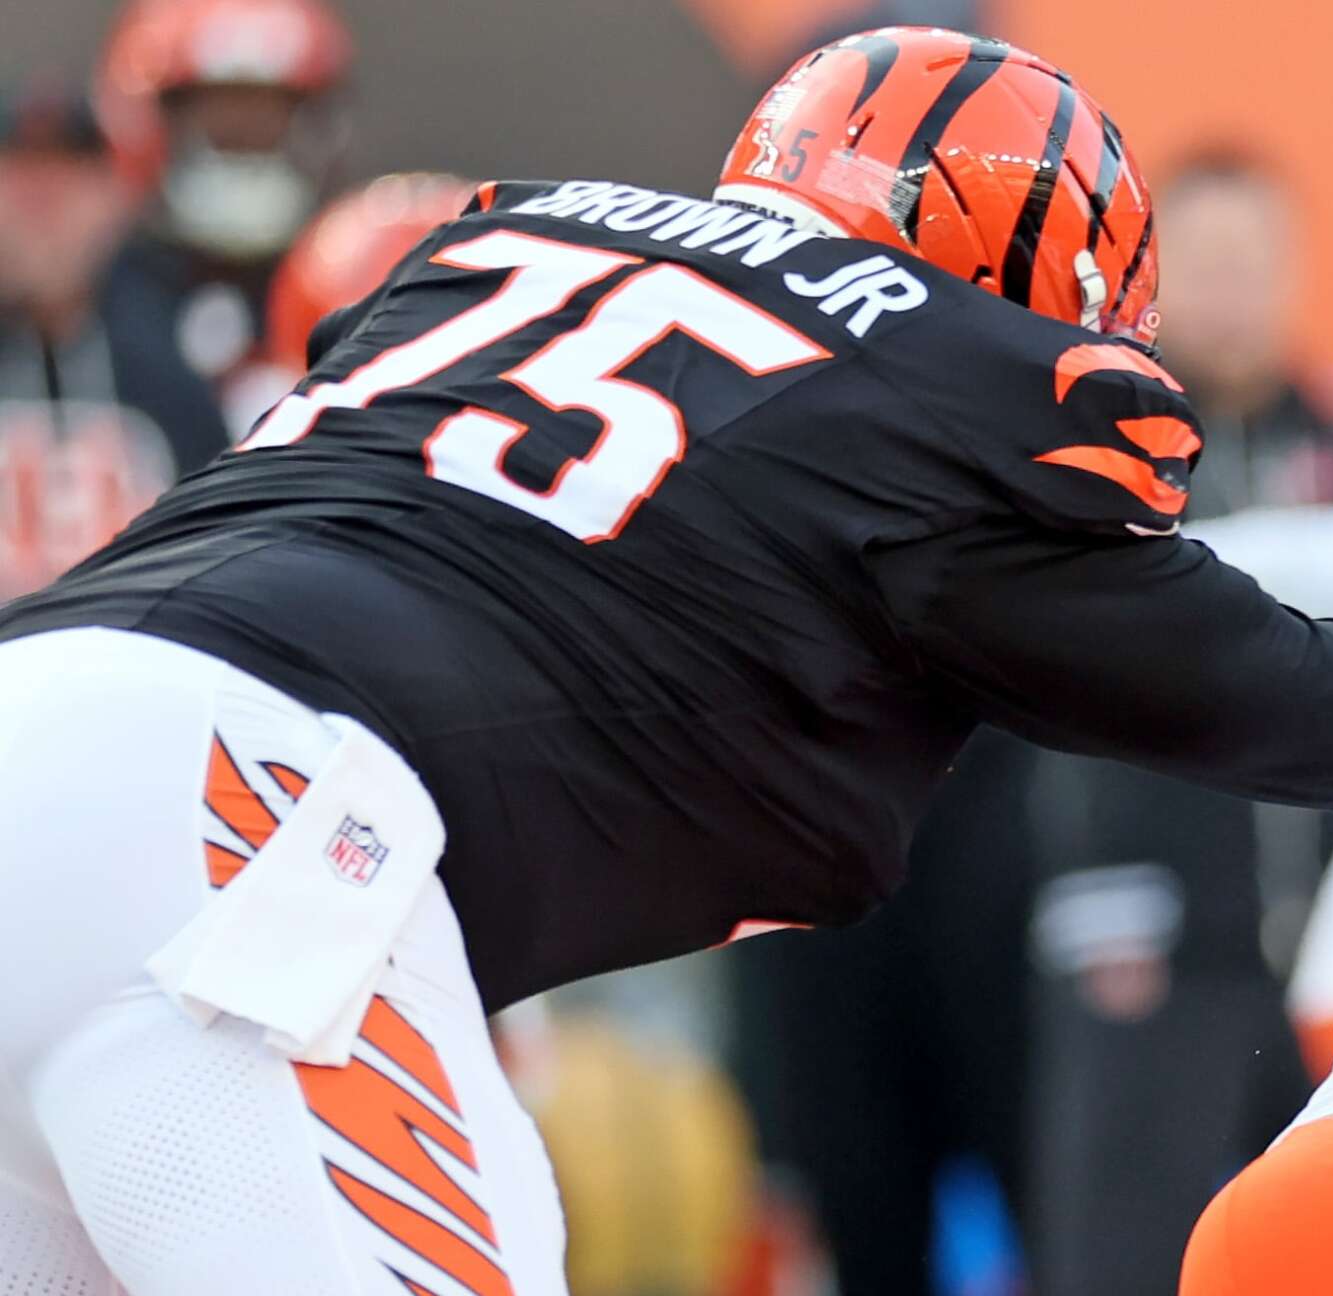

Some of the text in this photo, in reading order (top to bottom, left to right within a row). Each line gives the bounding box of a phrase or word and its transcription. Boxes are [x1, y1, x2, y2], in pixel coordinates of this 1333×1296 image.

[508, 180, 824, 268] BROWN
[783, 255, 929, 338] JR
[236, 228, 833, 544] 75
[328, 837, 369, 881] NFL
